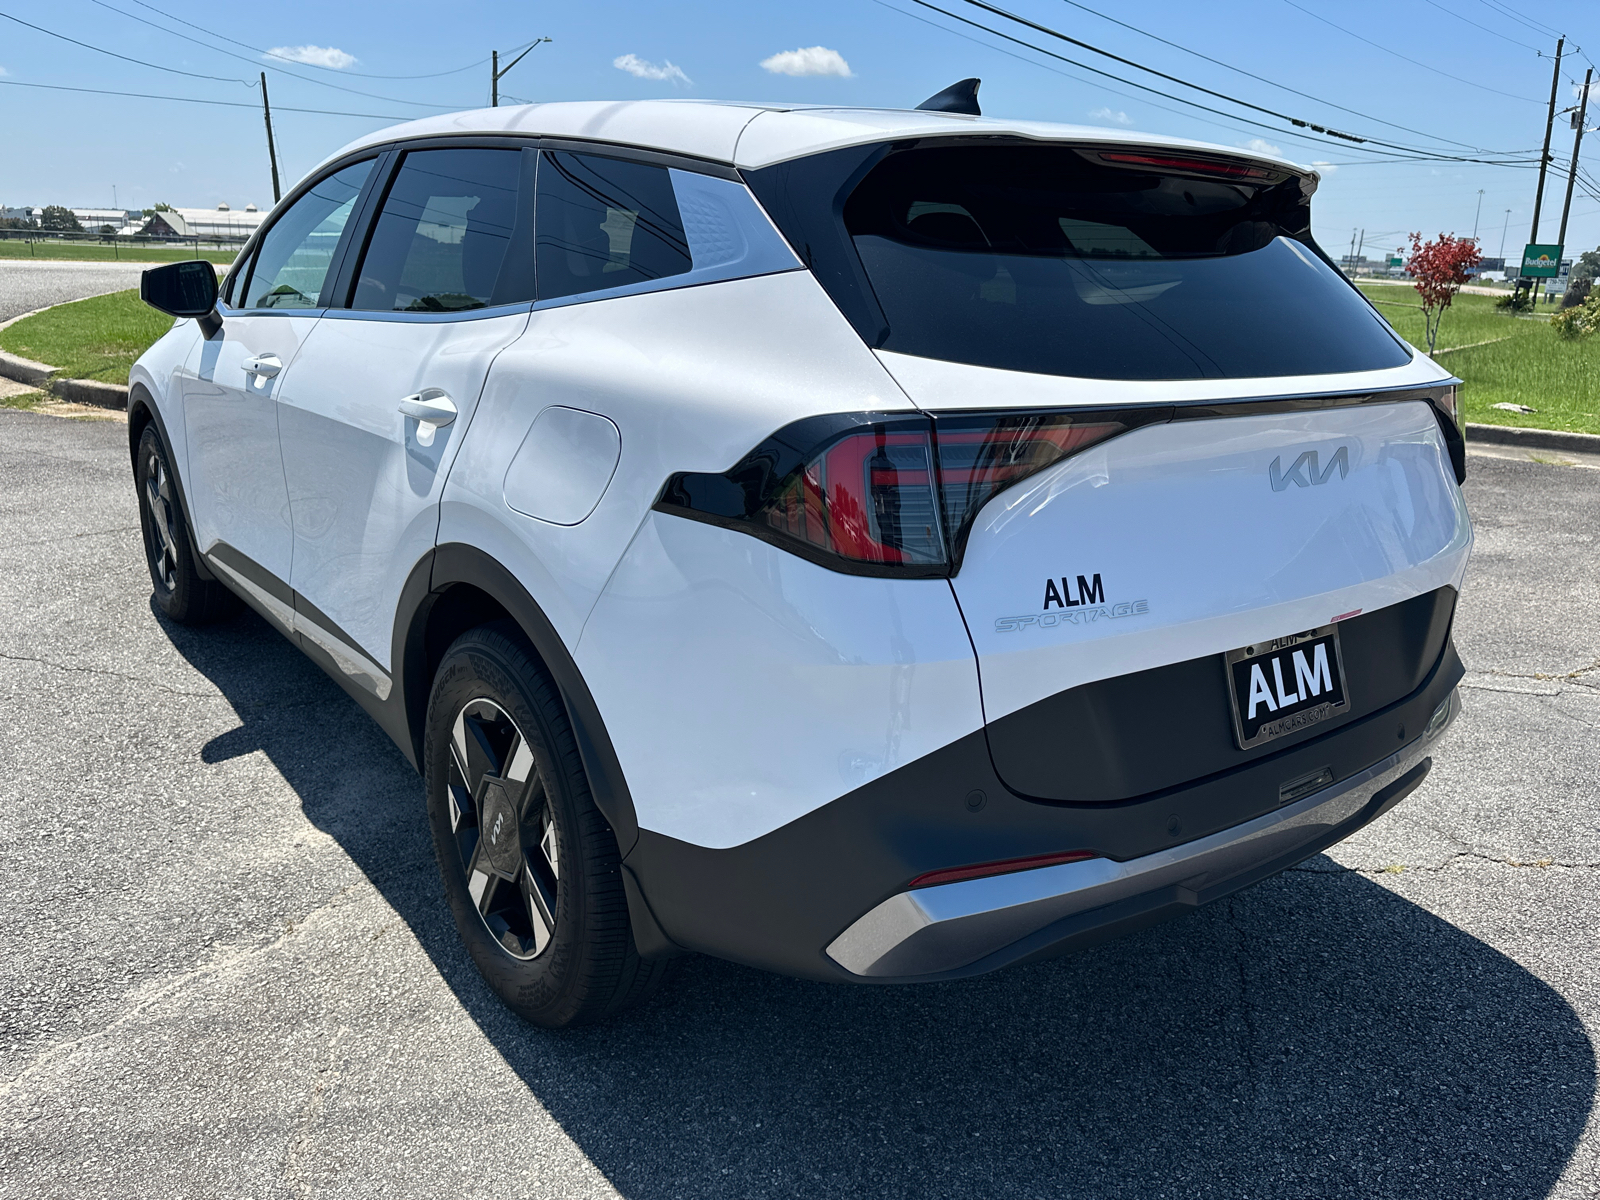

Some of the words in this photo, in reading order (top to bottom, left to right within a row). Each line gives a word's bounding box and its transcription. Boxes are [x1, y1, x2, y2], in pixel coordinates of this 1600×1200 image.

[1525, 256, 1557, 268] Budgetel
[1269, 446, 1349, 492] KIA
[1043, 573, 1105, 610] ALM
[995, 599, 1149, 633] SPORTAGE
[1270, 634, 1298, 651] ALM
[1248, 642, 1333, 720] ALM
[1268, 708, 1327, 737] ALMCARS.COM
